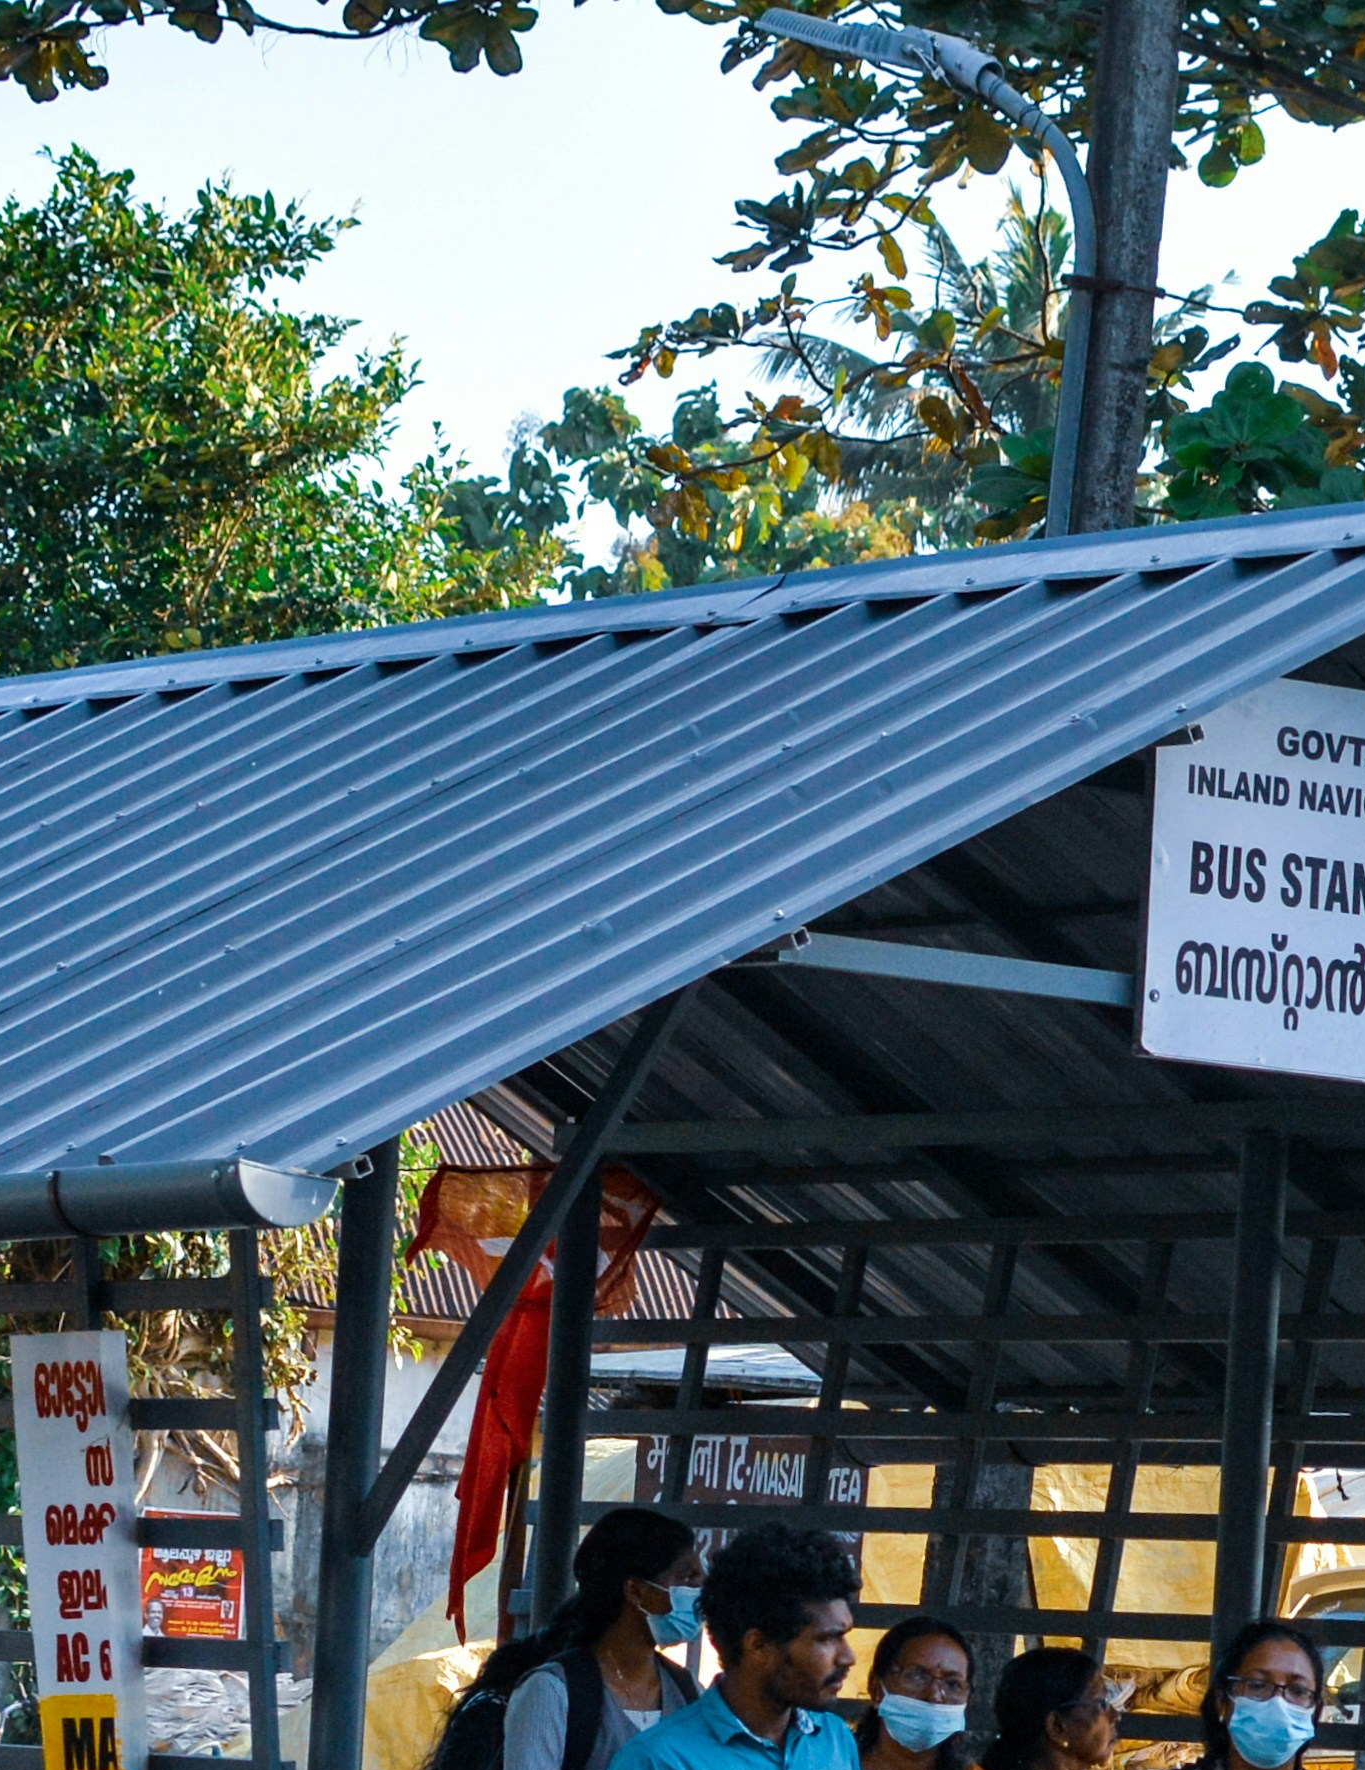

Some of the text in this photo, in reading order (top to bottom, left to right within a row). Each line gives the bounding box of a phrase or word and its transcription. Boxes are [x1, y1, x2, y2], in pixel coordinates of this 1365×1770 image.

[1187, 764, 1291, 807] INLAND
[1190, 840, 1268, 903] BUS
[828, 1467, 862, 1504] TEA
[56, 1632, 91, 1682] AC
